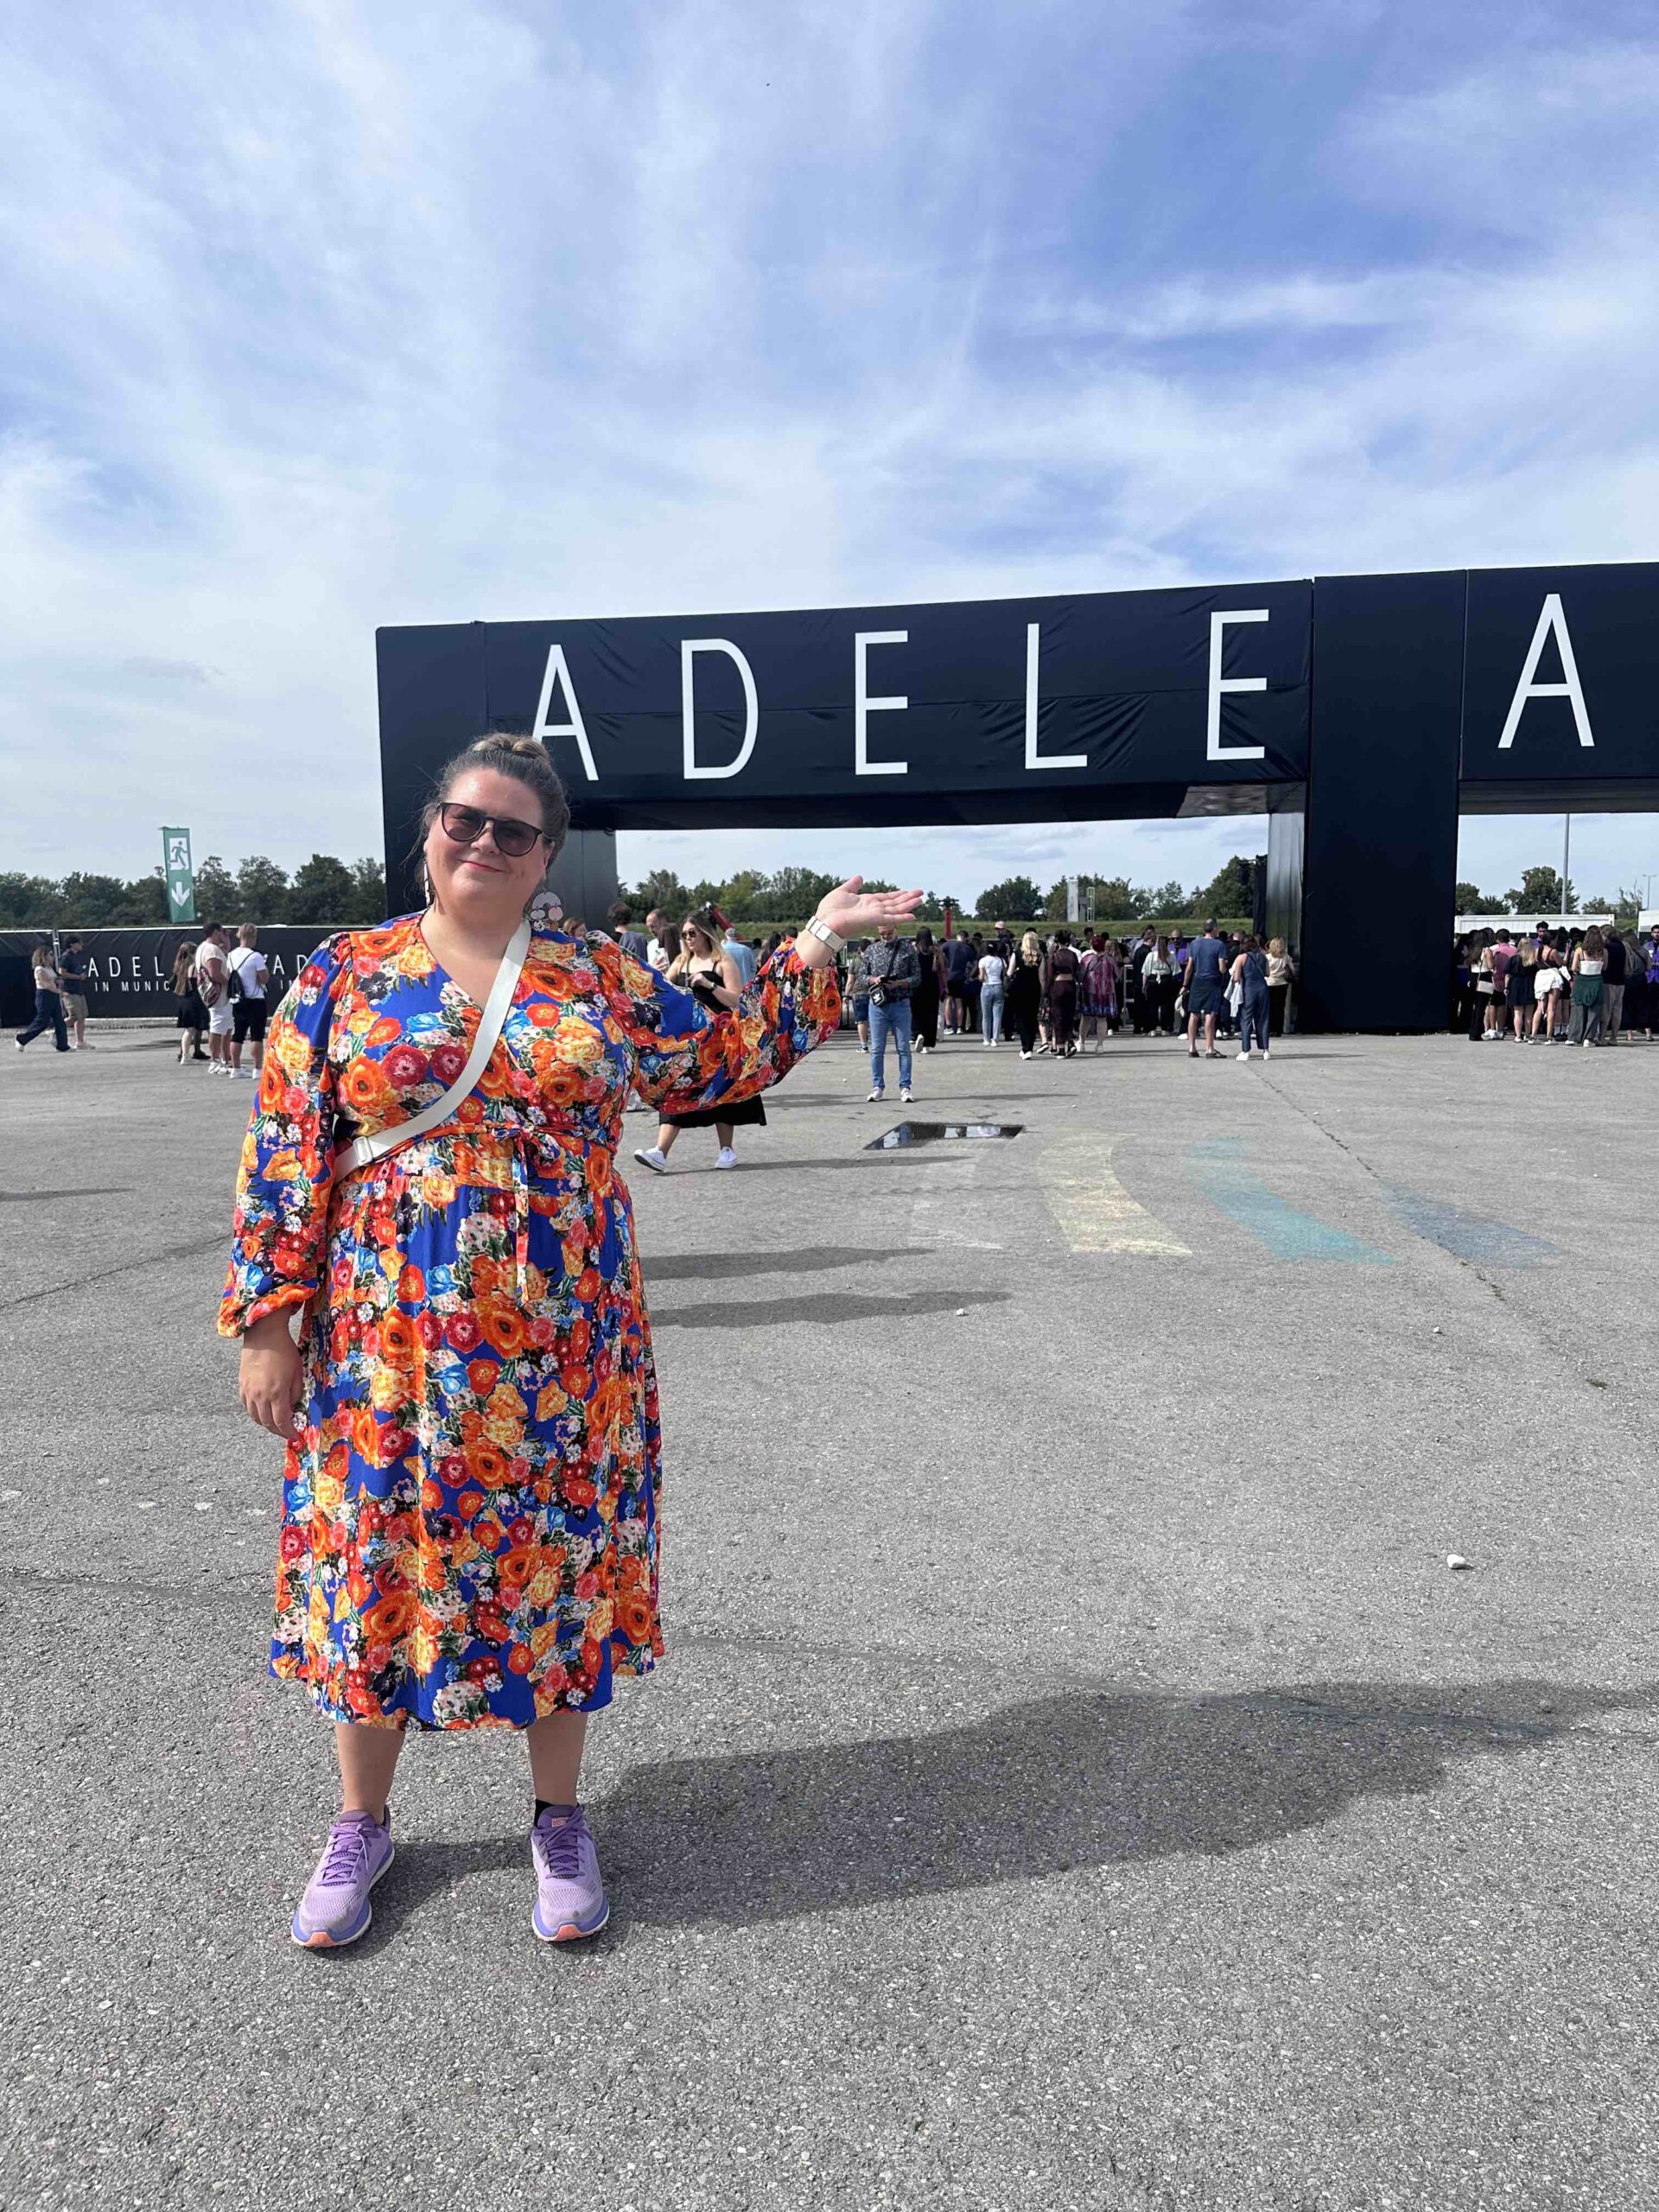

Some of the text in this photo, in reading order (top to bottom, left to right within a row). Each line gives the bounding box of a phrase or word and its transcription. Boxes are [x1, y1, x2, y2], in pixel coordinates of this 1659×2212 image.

[531, 609, 1269, 781] ADELE
[87, 956, 165, 978] ADEL
[94, 980, 171, 993] IN MUNIC
